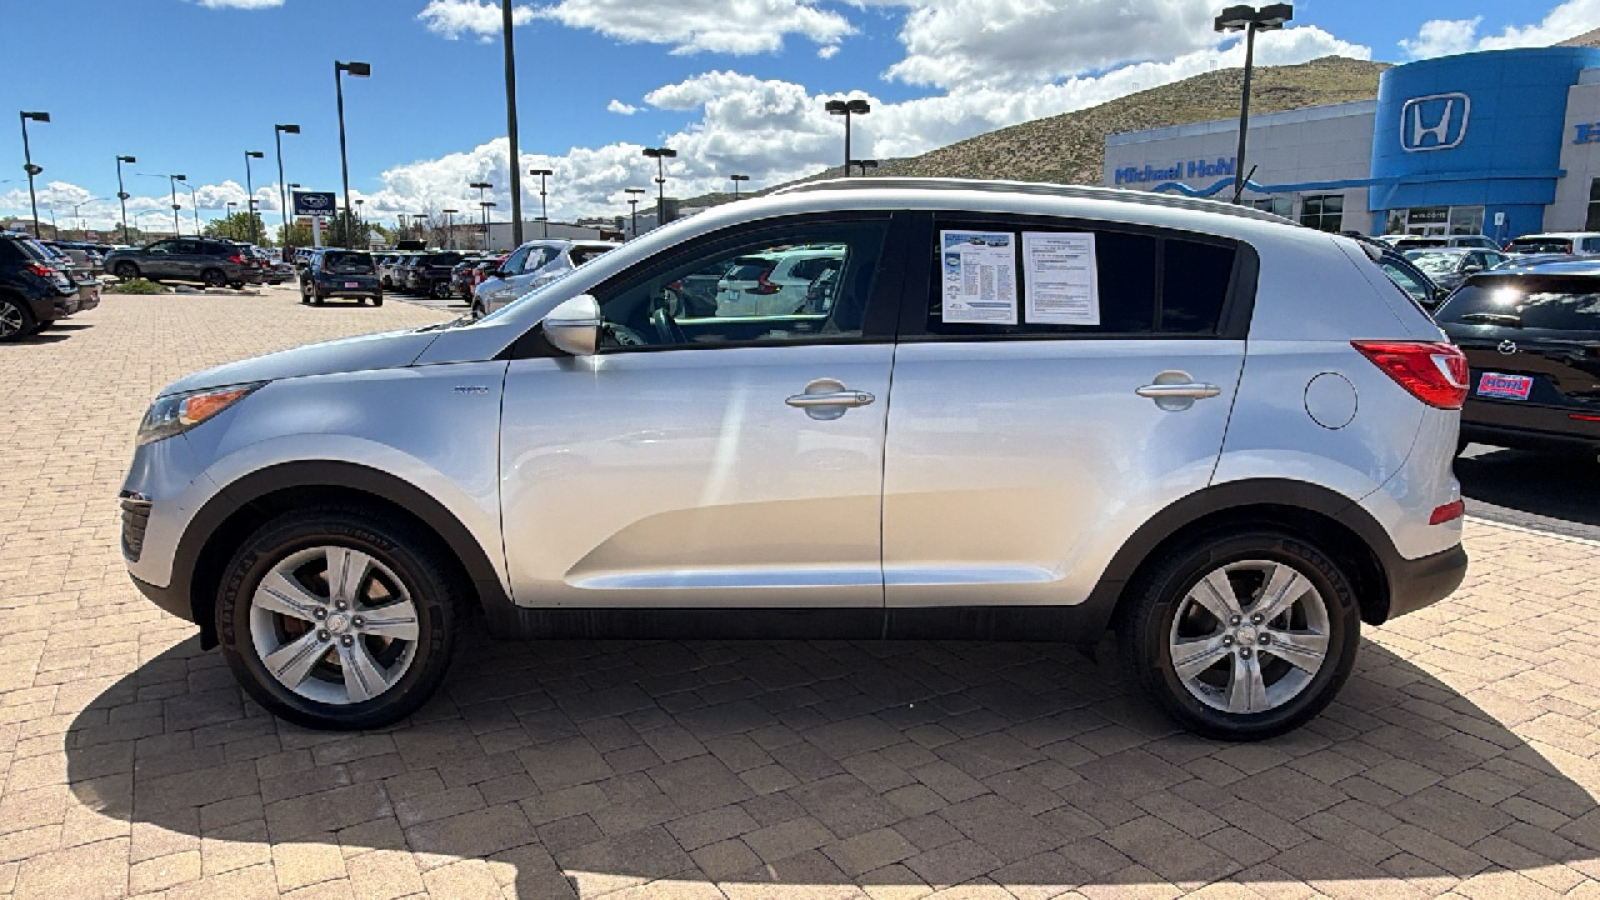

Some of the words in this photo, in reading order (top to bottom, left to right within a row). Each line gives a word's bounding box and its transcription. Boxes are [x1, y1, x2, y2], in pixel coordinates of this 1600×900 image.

[1114, 161, 1183, 185] Michael
[1187, 156, 1237, 179] Hohl
[1485, 378, 1523, 391] HOHL
